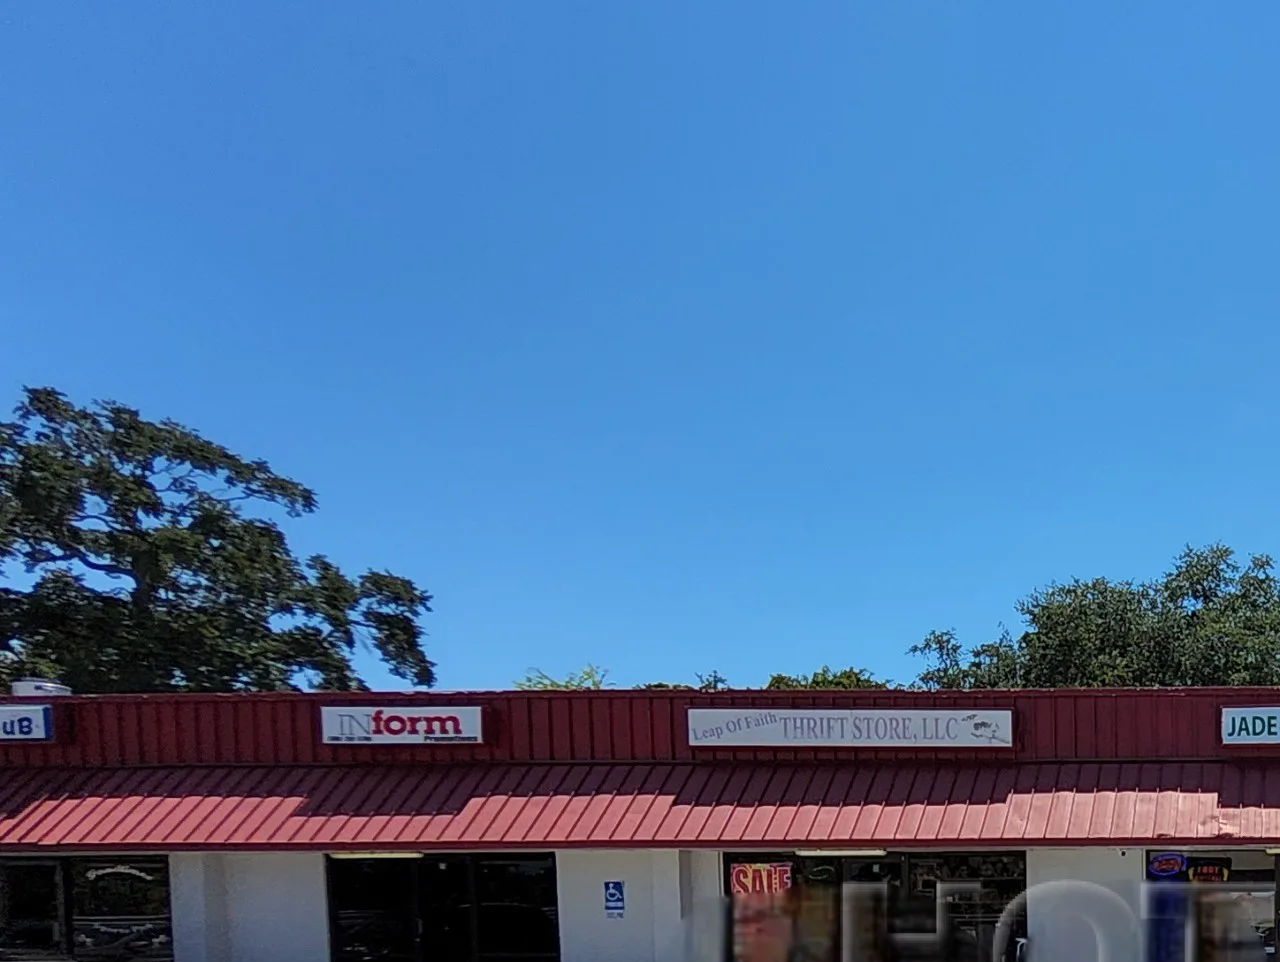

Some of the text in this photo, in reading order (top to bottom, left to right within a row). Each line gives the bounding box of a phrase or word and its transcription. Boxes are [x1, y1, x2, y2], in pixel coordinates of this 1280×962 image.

[692, 726, 723, 740] Leap
[744, 711, 778, 729] Faith
[779, 716, 849, 740] THRIFT
[852, 716, 918, 743] STORE,
[922, 717, 959, 741] LLC
[1227, 715, 1278, 737] JADE
